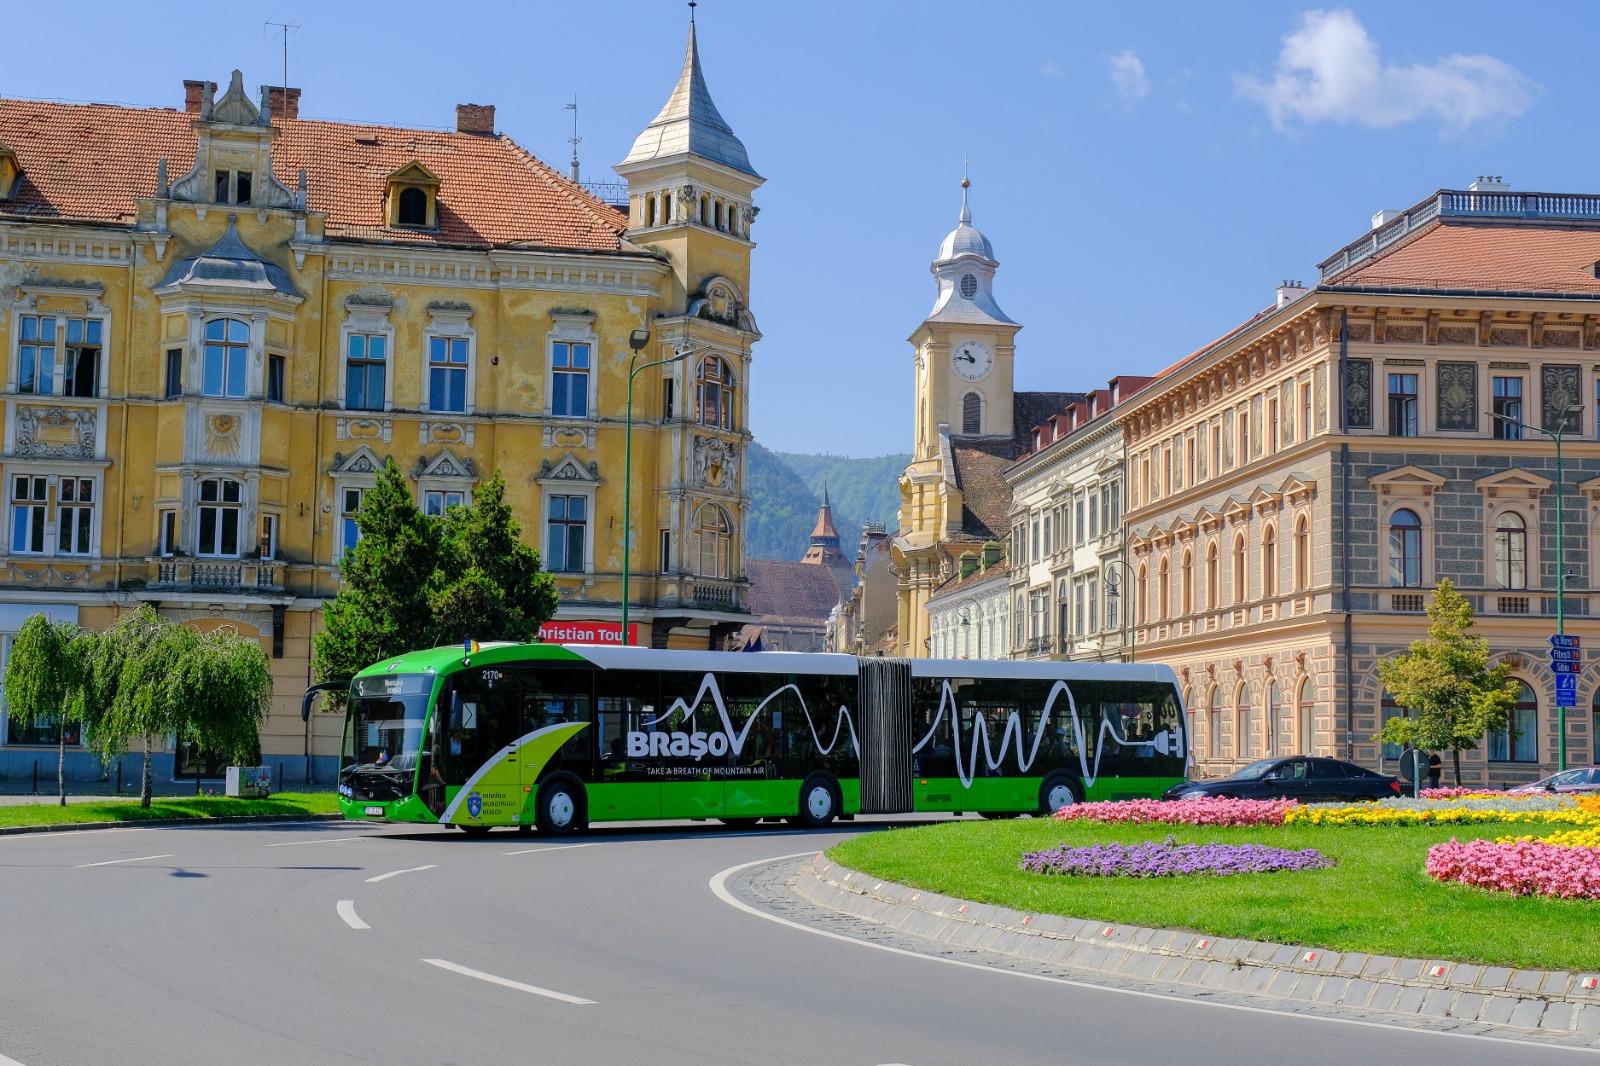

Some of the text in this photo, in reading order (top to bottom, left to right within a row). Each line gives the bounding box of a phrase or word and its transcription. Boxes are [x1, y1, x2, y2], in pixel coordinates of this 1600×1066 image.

[536, 626, 630, 641] hristian Tou
[1556, 662, 1570, 672] Sibiu
[482, 670, 499, 680] 2170
[358, 681, 364, 697] 5
[647, 767, 665, 775] TAKE
[673, 767, 701, 775] BREATH
[703, 767, 712, 775] OF
[714, 767, 751, 775] MOUNTAIN
[753, 766, 765, 775] AIR
